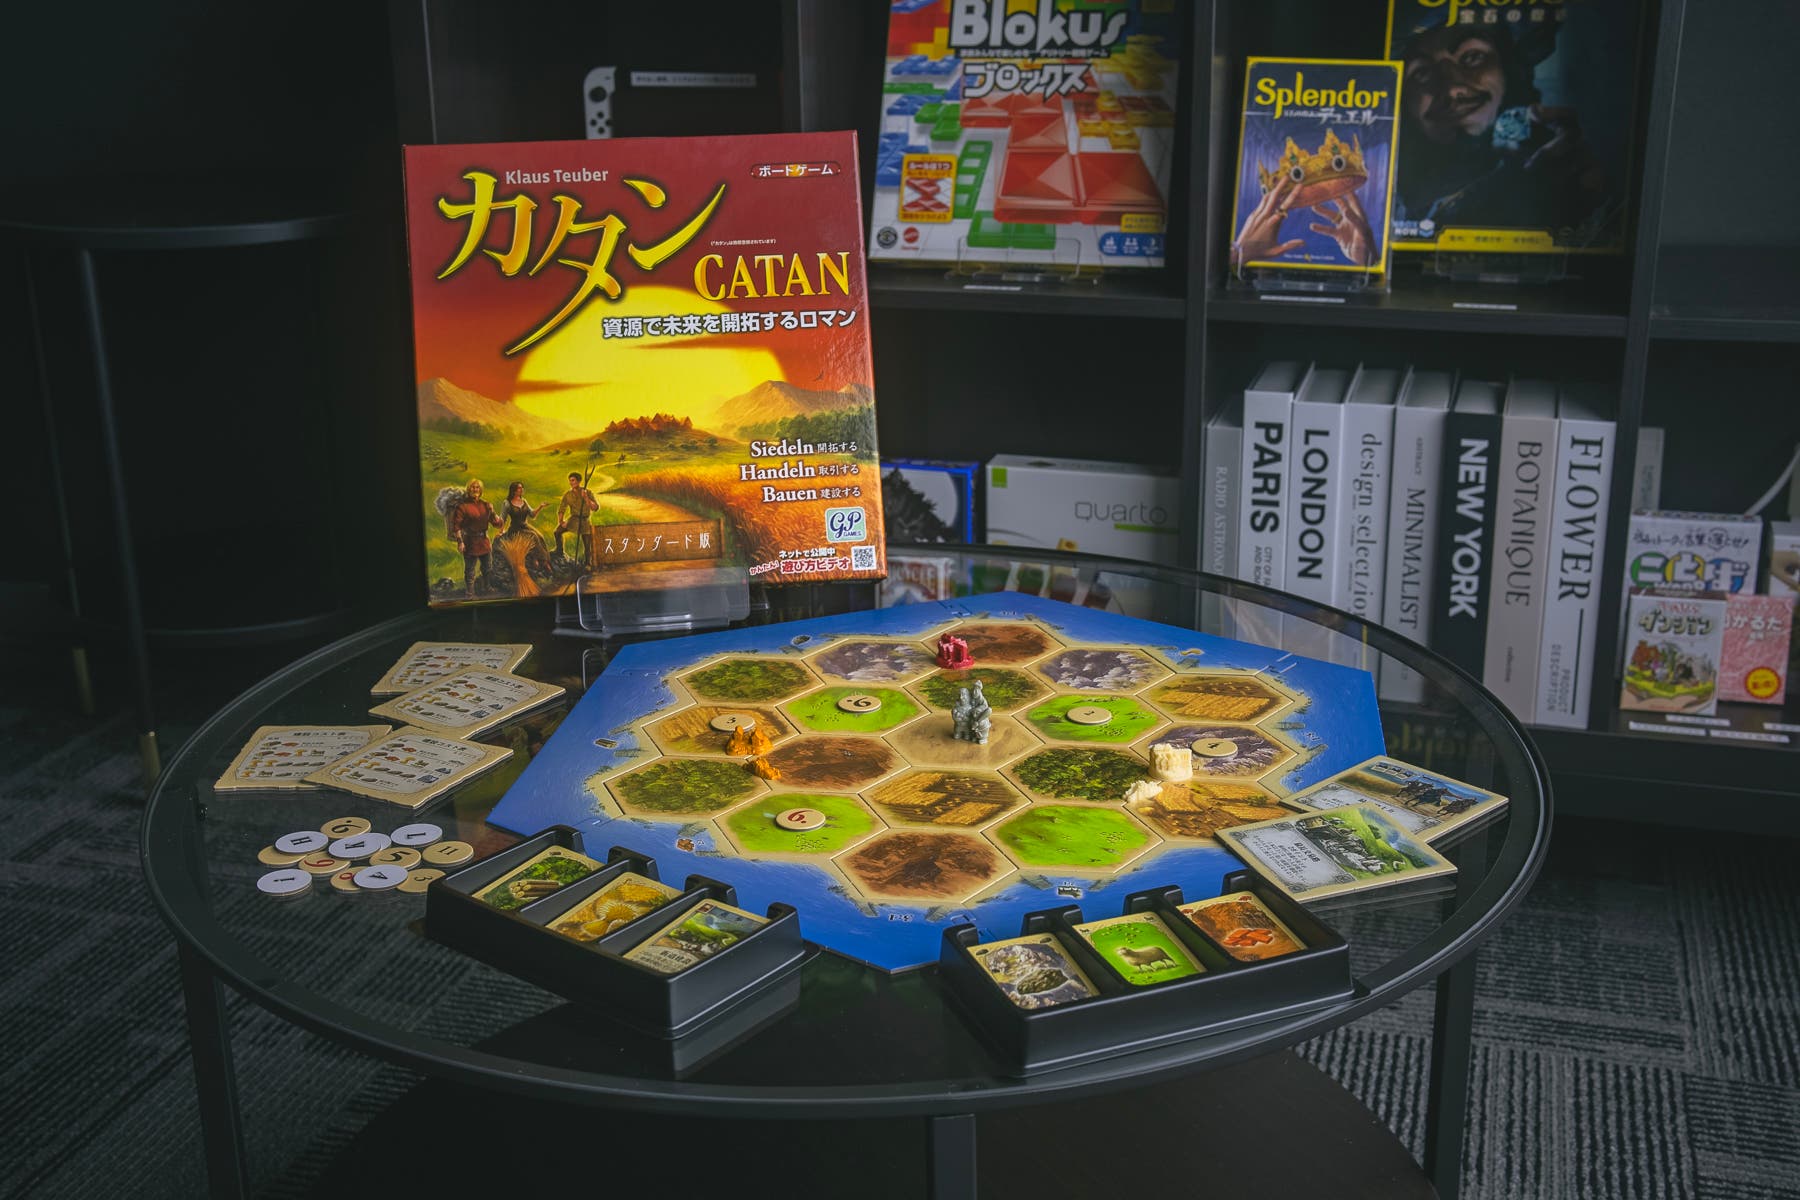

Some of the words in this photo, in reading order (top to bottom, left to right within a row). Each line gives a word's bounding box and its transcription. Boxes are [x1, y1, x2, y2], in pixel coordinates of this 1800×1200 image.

[950, 0, 1128, 50] Blokus
[961, 62, 1091, 100] ブロックス
[1255, 71, 1388, 120] Splendor
[505, 170, 550, 185] Klaus
[553, 168, 609, 183] Teuber
[758, 163, 834, 177] ボードゲーム
[438, 171, 726, 357] カタン
[694, 251, 850, 301] CATAN
[602, 309, 857, 338] 資源で未来を開拓するロマン
[751, 439, 815, 457] Siedeln
[817, 441, 857, 455] 開拓する
[740, 461, 816, 481] Handeln
[818, 463, 859, 477] 取引する
[1215, 465, 1229, 508] RADIO
[1249, 421, 1284, 534] PARIS
[1352, 433, 1383, 506] design
[1456, 438, 1489, 523] NEW
[762, 485, 817, 503] Bauen
[820, 487, 861, 500] 建設する
[1297, 429, 1331, 580] LONDON
[830, 510, 861, 539] GP
[1505, 441, 1543, 607] BOTANIQUE
[1558, 436, 1605, 602] FLOWER
[604, 532, 711, 554] スタンダード版
[778, 548, 836, 560] ネットで公開中
[1400, 488, 1427, 630] MINIMALIST
[781, 557, 850, 573] 遊び方ビデオ
[1448, 529, 1483, 618] YORK
[368, 871, 389, 880] A
[379, 851, 412, 863] 5
